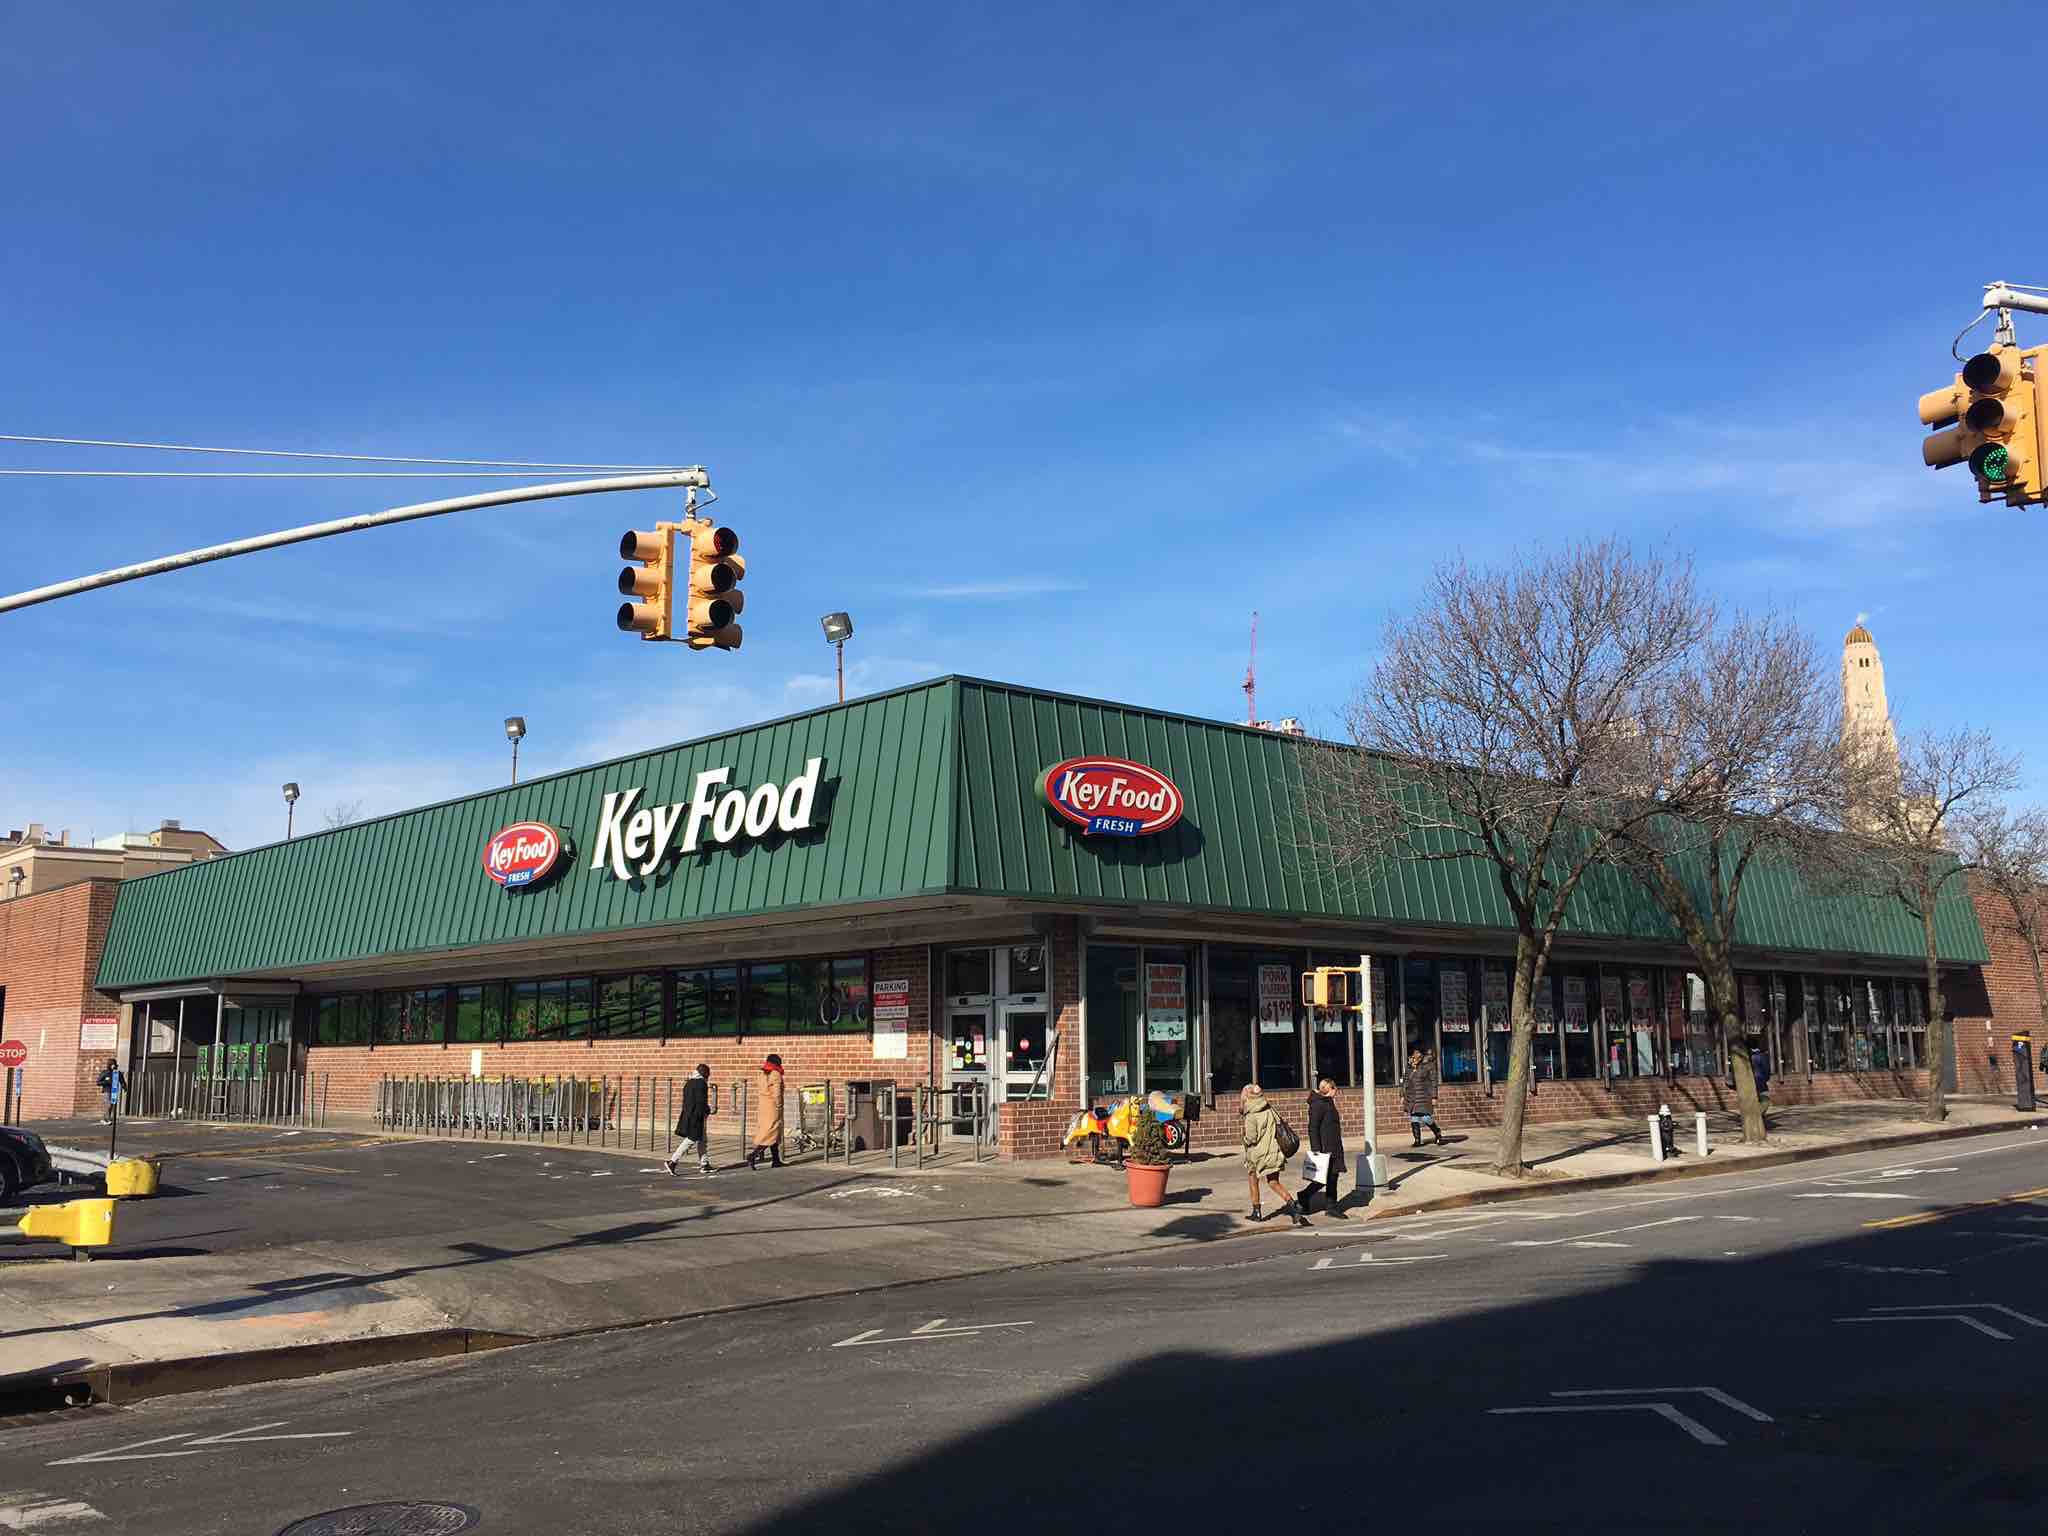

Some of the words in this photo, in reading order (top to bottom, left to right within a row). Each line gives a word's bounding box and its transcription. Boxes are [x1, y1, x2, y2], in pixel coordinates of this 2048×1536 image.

[1058, 770, 1108, 810] Key
[1107, 777, 1167, 812] Food
[590, 787, 687, 880] Key
[680, 757, 822, 853] Food
[1095, 818, 1134, 833] FRESH
[490, 841, 515, 871] Key
[513, 836, 549, 863] Food
[508, 871, 531, 883] FRESH
[875, 982, 907, 993] PARKING
[0, 1048, 26, 1058] STOP
